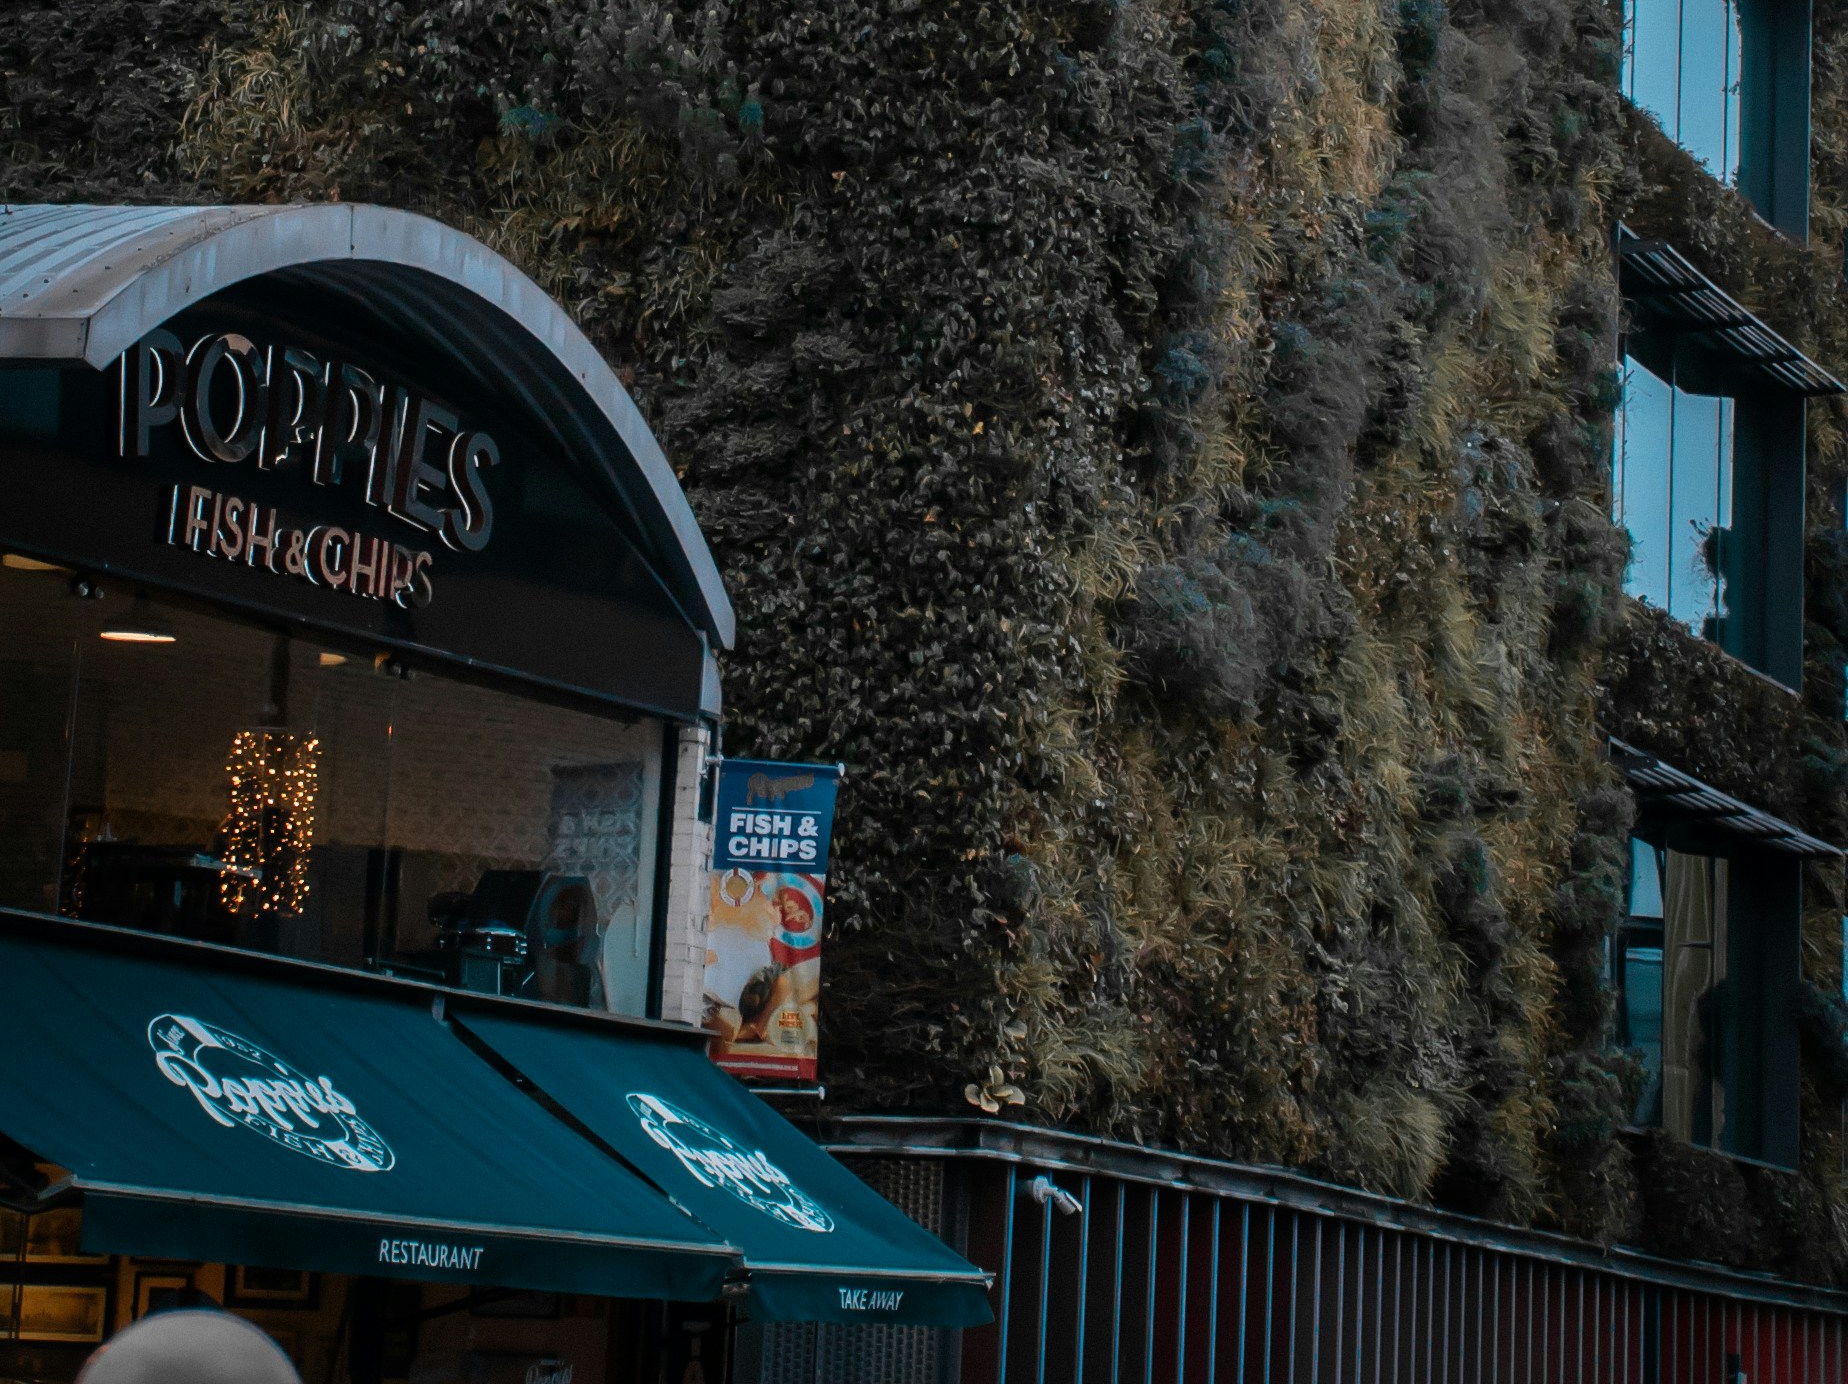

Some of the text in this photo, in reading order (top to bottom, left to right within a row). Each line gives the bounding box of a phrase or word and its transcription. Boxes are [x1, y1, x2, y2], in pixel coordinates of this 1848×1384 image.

[119, 327, 501, 552] POPPIES
[167, 482, 434, 609] FISH & CHIPS
[729, 812, 819, 837] FISH &
[728, 836, 817, 861] CHIPS
[156, 1051, 356, 1128] Poppies
[379, 1239, 484, 1270] RESTAURANT
[839, 1288, 904, 1311] TAKE AWAY
